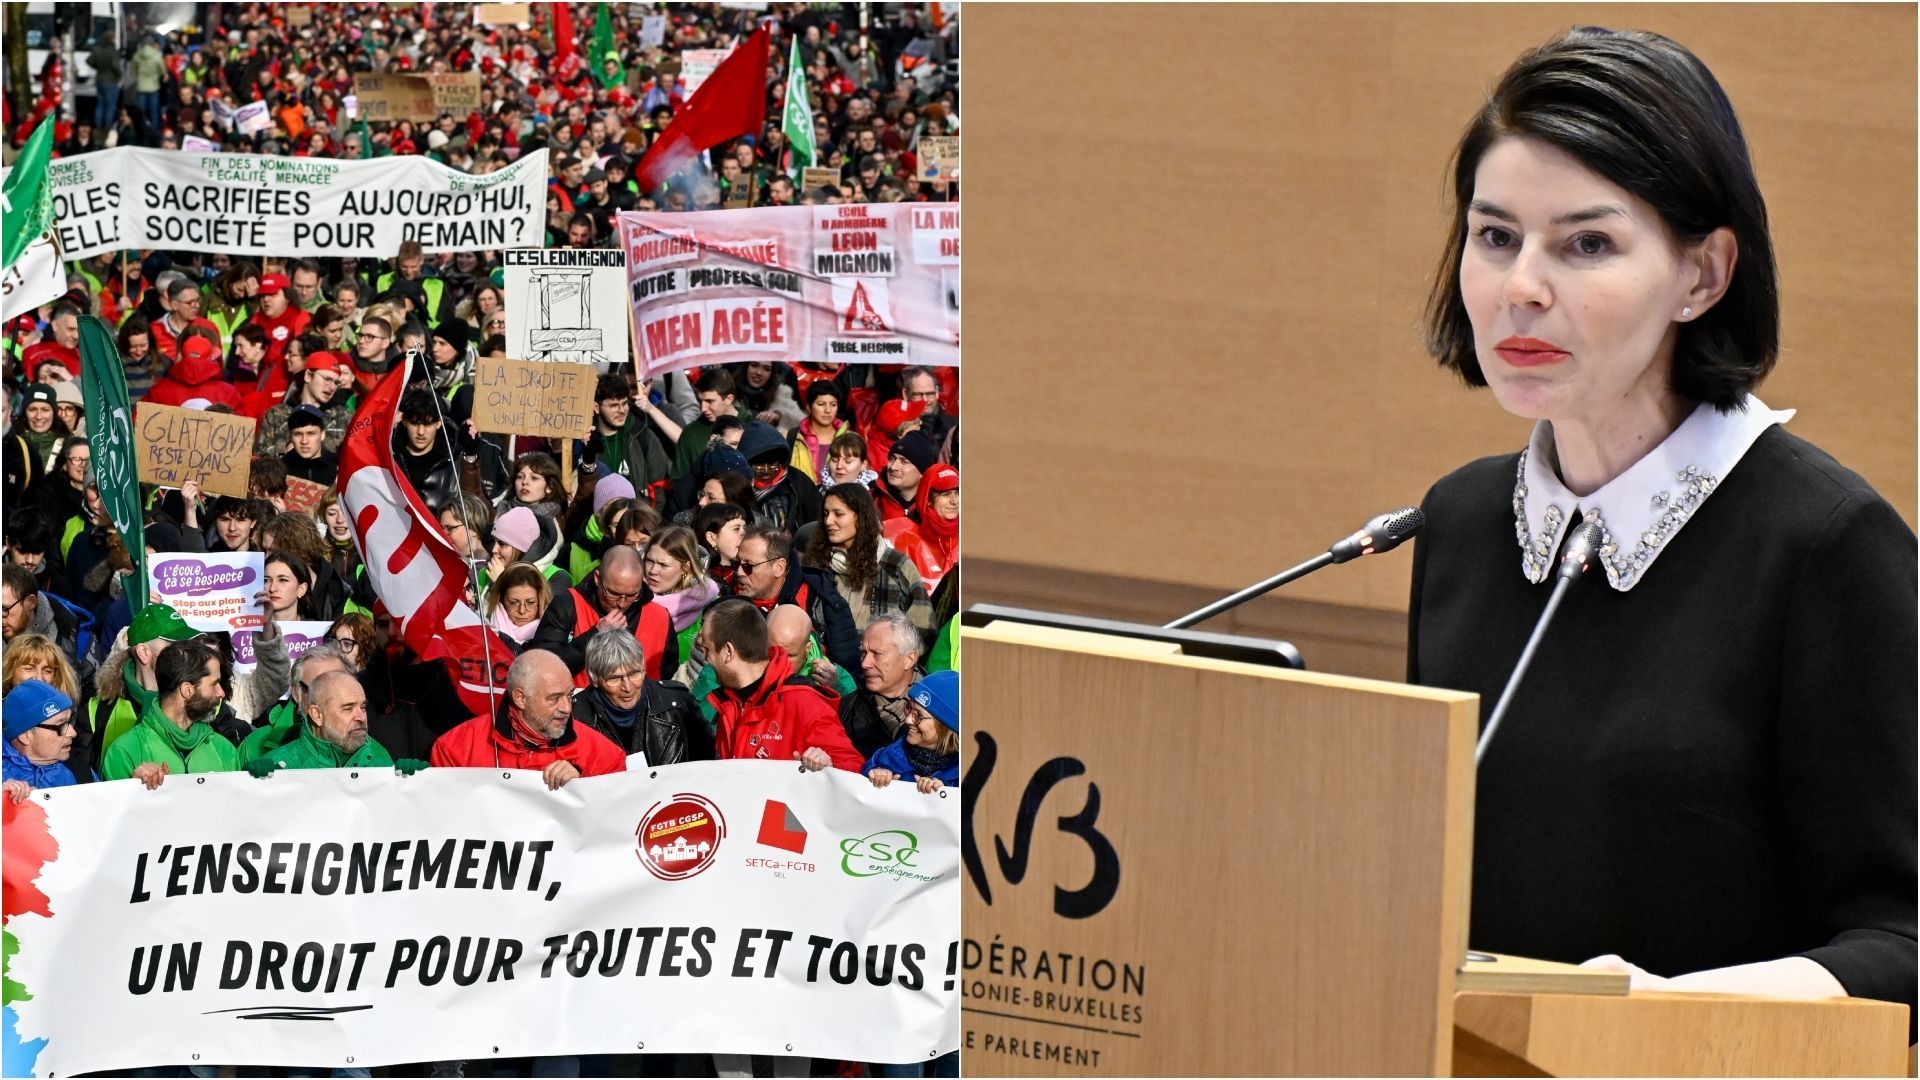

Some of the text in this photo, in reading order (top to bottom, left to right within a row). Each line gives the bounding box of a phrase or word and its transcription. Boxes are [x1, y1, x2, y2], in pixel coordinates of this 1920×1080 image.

[201, 157, 339, 173] FIN DES NOMINATIONS
[450, 180, 465, 191] DE
[144, 182, 531, 217] SACRIFIÉES AUJOURD'HUI,
[914, 211, 936, 229] LA
[146, 214, 266, 247] SOCIÉTÉ
[294, 222, 375, 249] POUR
[832, 232, 877, 252] LEON
[818, 252, 892, 274] MIGNON
[633, 271, 676, 302] NOTRE
[645, 301, 784, 361] MEN ACÉE
[481, 363, 578, 390] LA DROITE
[487, 391, 512, 407] ON
[547, 396, 578, 412] MET
[493, 410, 583, 431] UNE DROITE
[149, 445, 232, 474] RESTE DANS
[149, 468, 178, 483] TON
[172, 595, 246, 610] Stop aux plans
[650, 812, 704, 832] FGTB CGSP
[840, 834, 919, 871] CSC
[130, 839, 562, 904] L'ENSEIGNEMENT,
[745, 858, 816, 873] SETCa-FGTB
[774, 871, 787, 879] SEL
[128, 941, 203, 995] UN
[219, 940, 376, 994] DROIT
[384, 935, 524, 990] POUR
[540, 926, 716, 979] TOUTES
[731, 928, 793, 978] ET
[807, 934, 926, 991] TOUS
[962, 934, 1145, 997] DÉRATION
[961, 1031, 1101, 1068] E PARLEMENT
